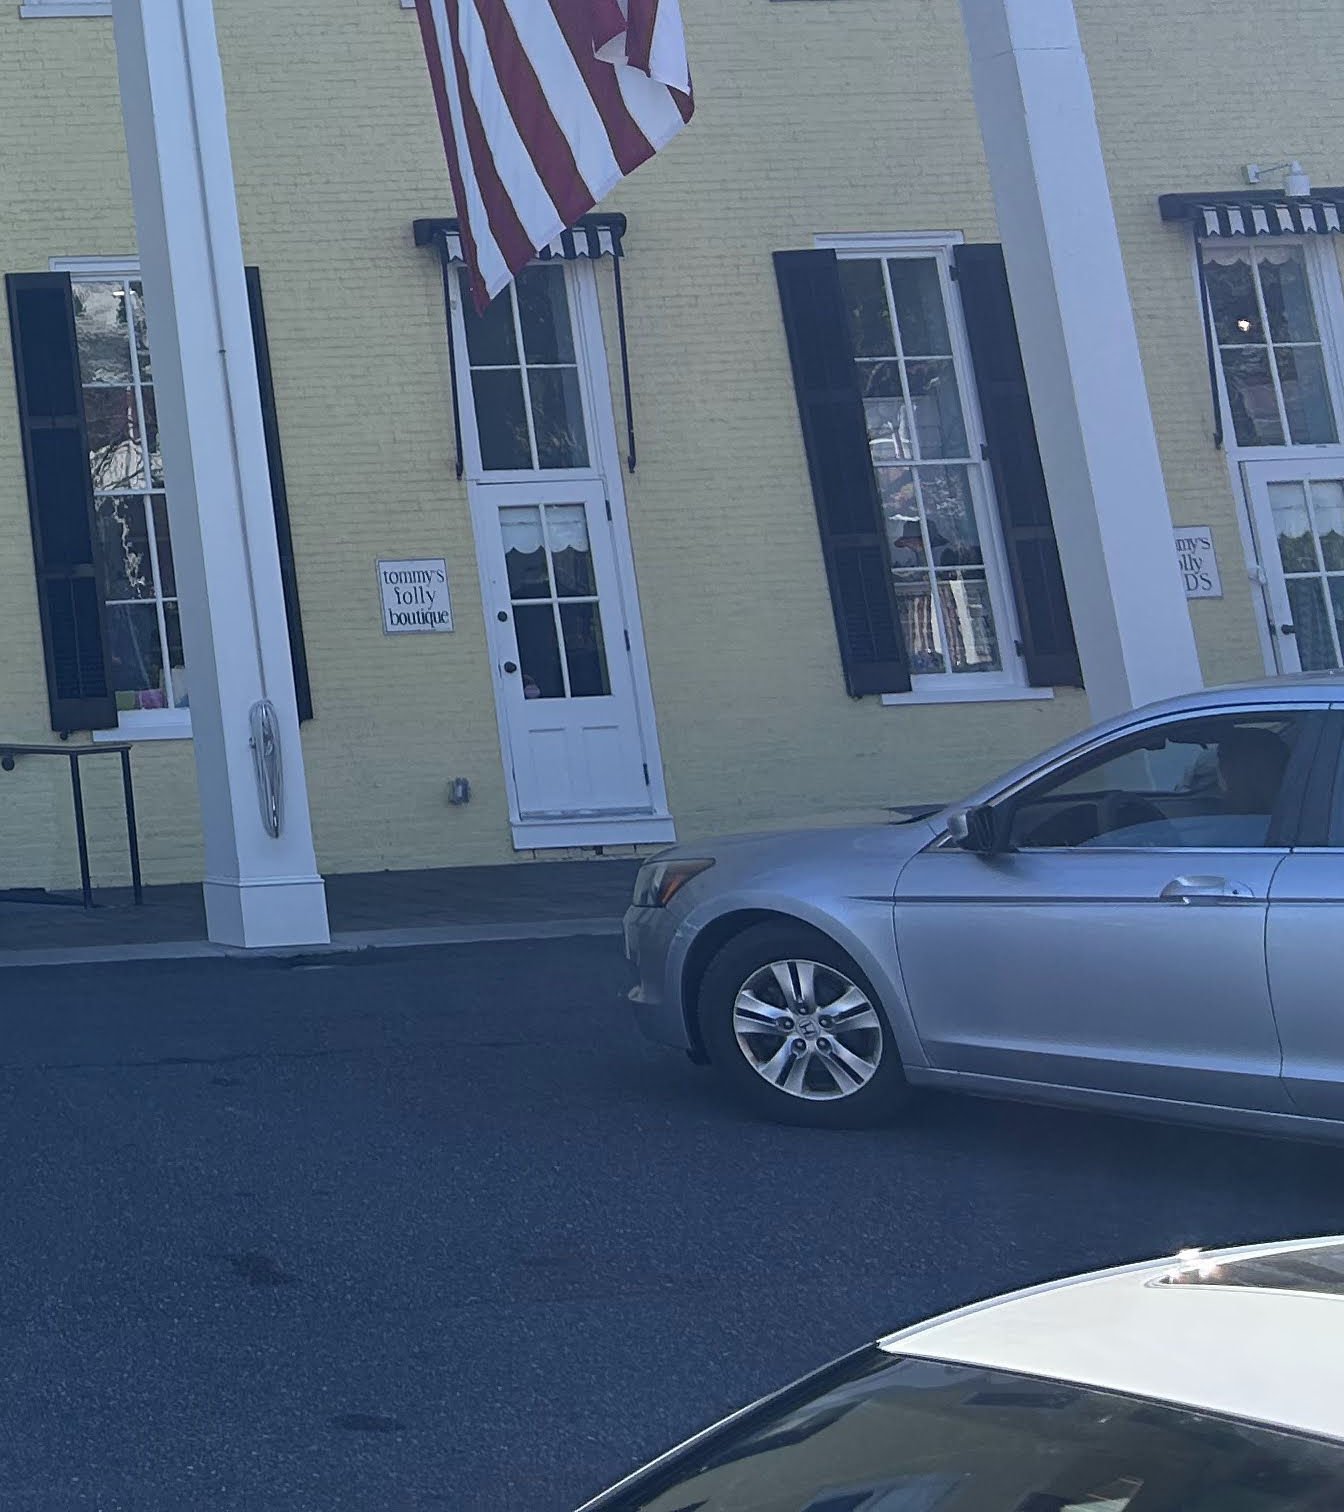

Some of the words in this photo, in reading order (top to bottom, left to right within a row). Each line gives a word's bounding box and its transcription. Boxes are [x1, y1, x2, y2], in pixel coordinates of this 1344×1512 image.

[1175, 537, 1211, 554] my's
[1178, 554, 1202, 574] lly
[383, 569, 445, 587] tommy's
[1184, 573, 1212, 591] DS
[394, 586, 436, 610] folly
[388, 608, 449, 628] boutique
